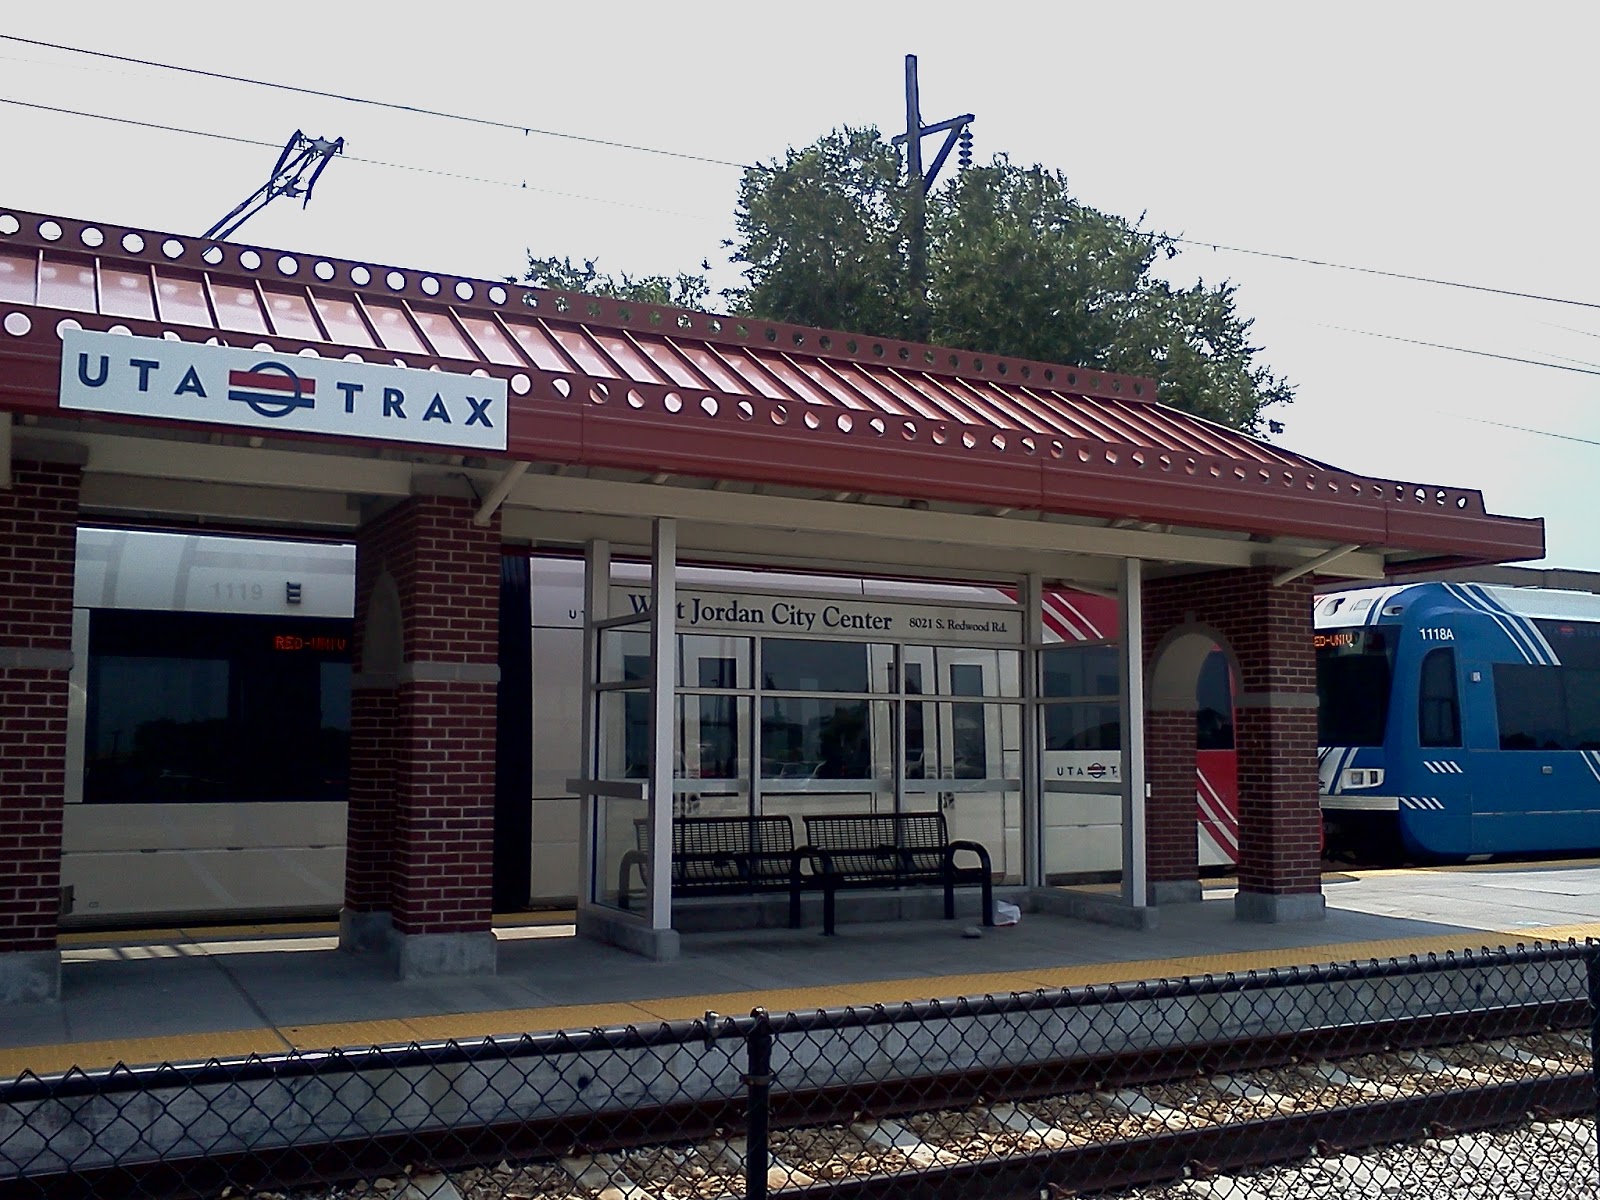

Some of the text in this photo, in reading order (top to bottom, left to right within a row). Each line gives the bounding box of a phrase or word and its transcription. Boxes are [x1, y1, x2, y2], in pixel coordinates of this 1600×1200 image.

[78, 352, 494, 428] UTA TRAX
[209, 582, 263, 600] 1119
[628, 594, 1008, 633] Wt Jordan City Center 8021 S. Redwood Rd.
[1419, 628, 1455, 641] 1118A
[1057, 766, 1084, 776] UTA
